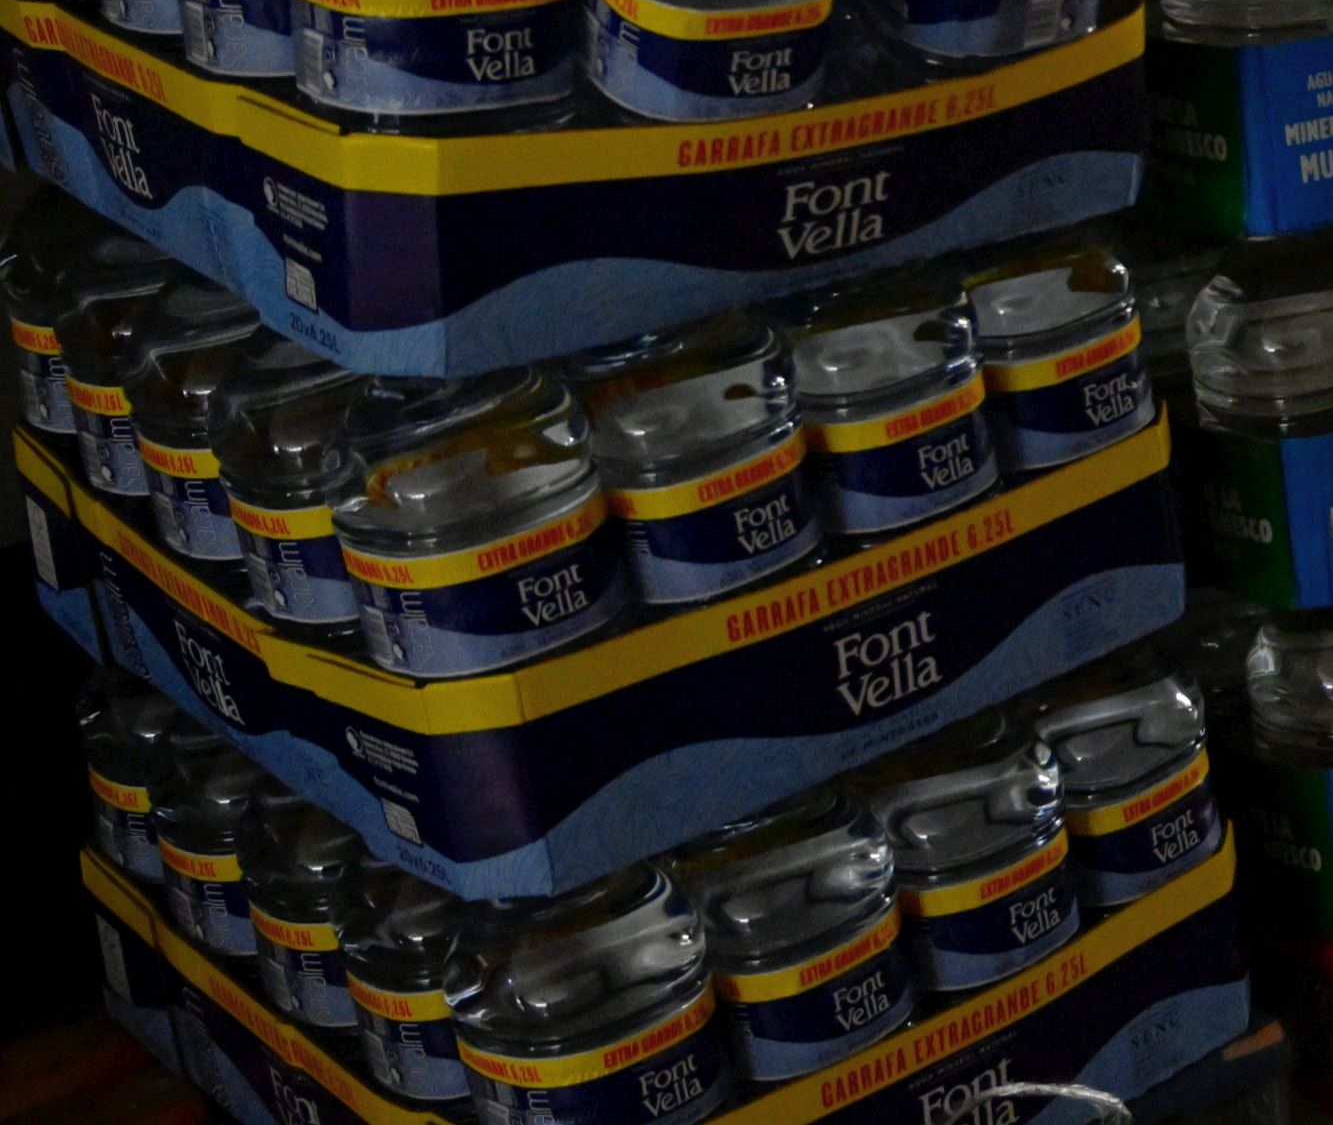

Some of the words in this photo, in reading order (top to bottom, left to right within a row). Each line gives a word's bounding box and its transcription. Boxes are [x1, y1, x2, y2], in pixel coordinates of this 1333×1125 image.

[466, 26, 535, 55] Font
[730, 46, 794, 73] Font
[467, 52, 536, 82] Vella
[727, 70, 792, 97] Vella
[678, 129, 781, 169] GARRAFA
[789, 96, 938, 154] EXTRAGRANDE
[783, 167, 894, 224] Font
[777, 208, 887, 262] Vella
[1082, 374, 1131, 407] Font
[1085, 389, 1136, 428] Vella
[916, 434, 972, 471] Font
[920, 454, 976, 492] Vella
[732, 492, 791, 537] Font
[736, 514, 798, 556] Vella
[517, 563, 587, 605] Font
[726, 593, 820, 644] GARRAFA
[826, 535, 961, 607] EXTRAGRANDE
[520, 588, 590, 628] Vella
[833, 608, 939, 682] Font
[835, 652, 944, 718] Vella
[1149, 807, 1195, 847] Font
[1152, 827, 1201, 865] Vella
[1008, 886, 1057, 928] Font
[1011, 909, 1062, 947] Vella
[831, 969, 887, 1014] Font
[836, 991, 891, 1034] Vella
[821, 1048, 908, 1110] GARRAFA
[913, 979, 1039, 1065] EXTRAGRANDE
[637, 1052, 700, 1098] Font
[919, 1058, 1013, 1124] Font
[639, 1075, 703, 1120] Vella
